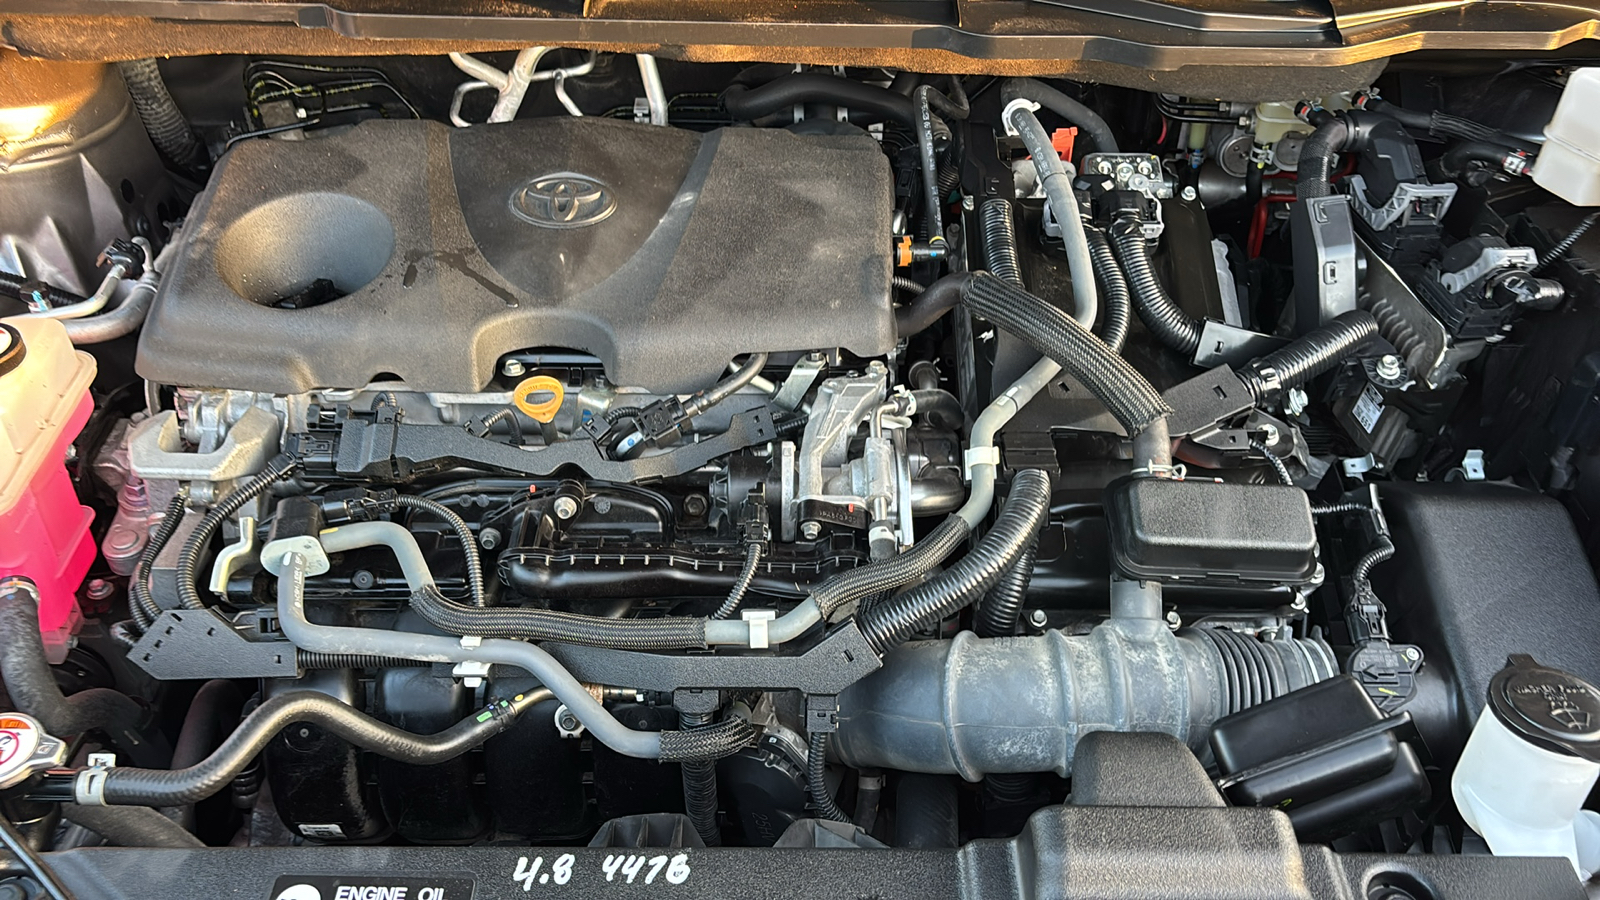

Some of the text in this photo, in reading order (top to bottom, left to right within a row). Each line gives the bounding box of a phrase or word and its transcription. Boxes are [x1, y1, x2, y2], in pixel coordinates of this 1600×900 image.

[513, 853, 575, 891] 4.8
[335, 885, 445, 900] ENGINE OIL
